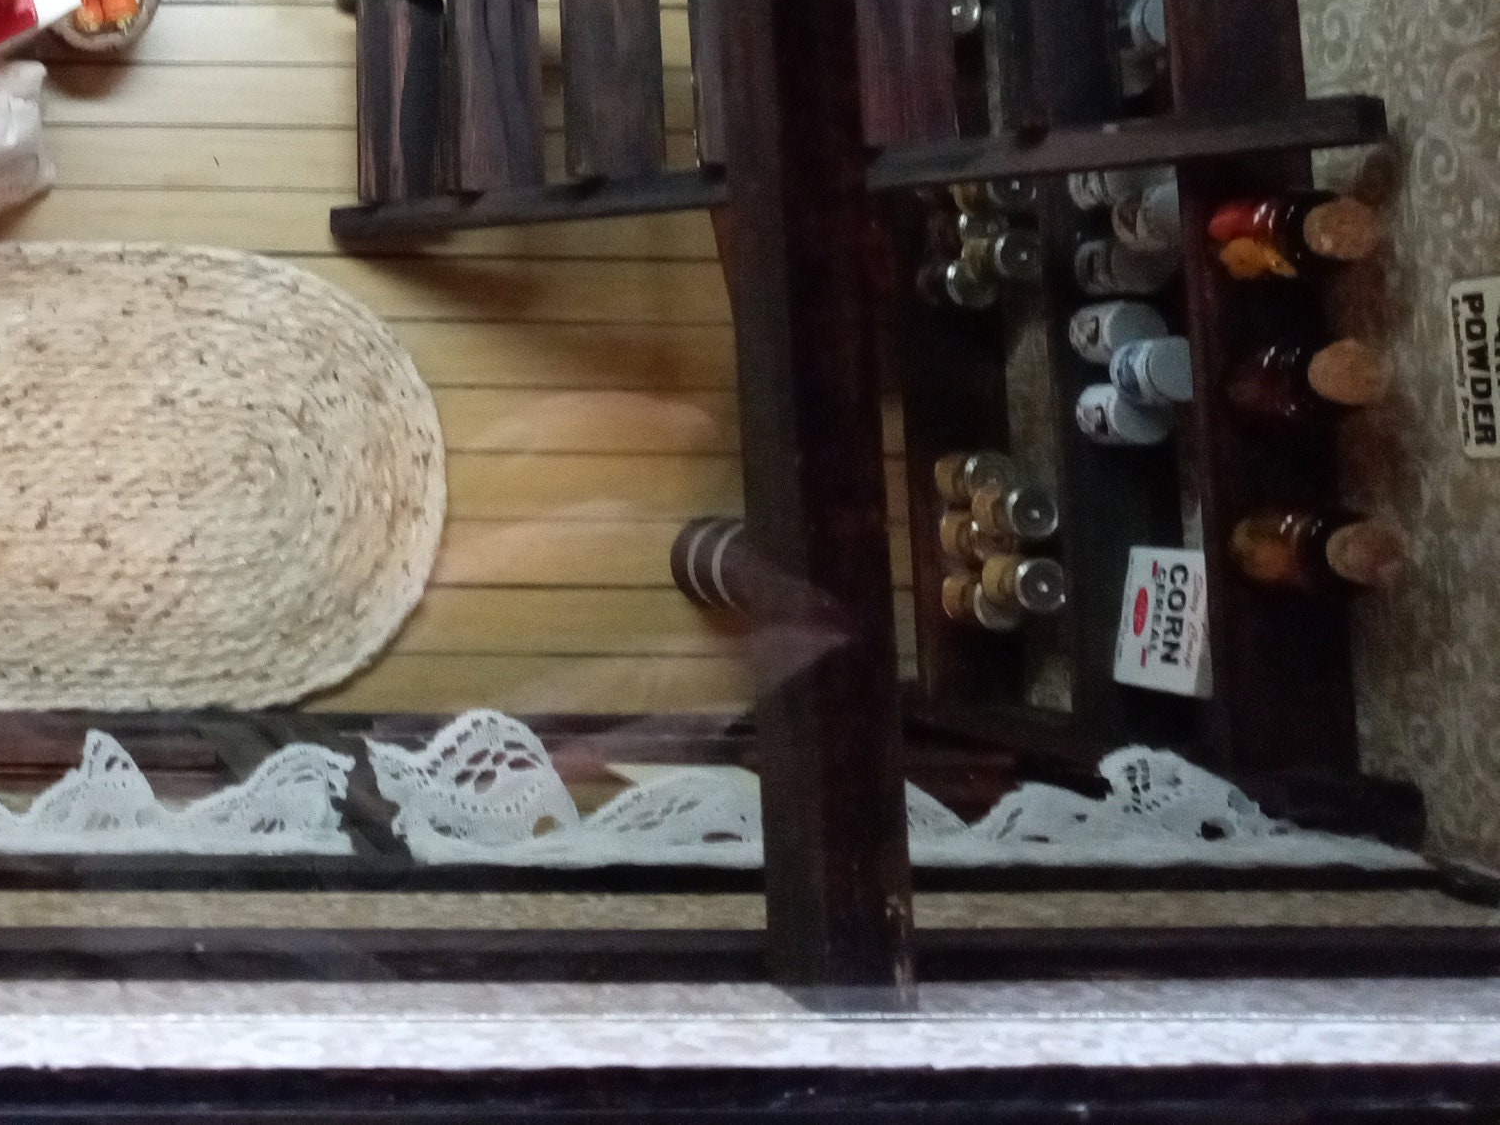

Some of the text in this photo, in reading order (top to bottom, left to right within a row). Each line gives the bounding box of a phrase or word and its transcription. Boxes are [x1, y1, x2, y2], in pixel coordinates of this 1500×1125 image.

[1462, 292, 1497, 446] POWDER
[1148, 567, 1167, 653] CEREAL
[1160, 563, 1190, 665] CORN
